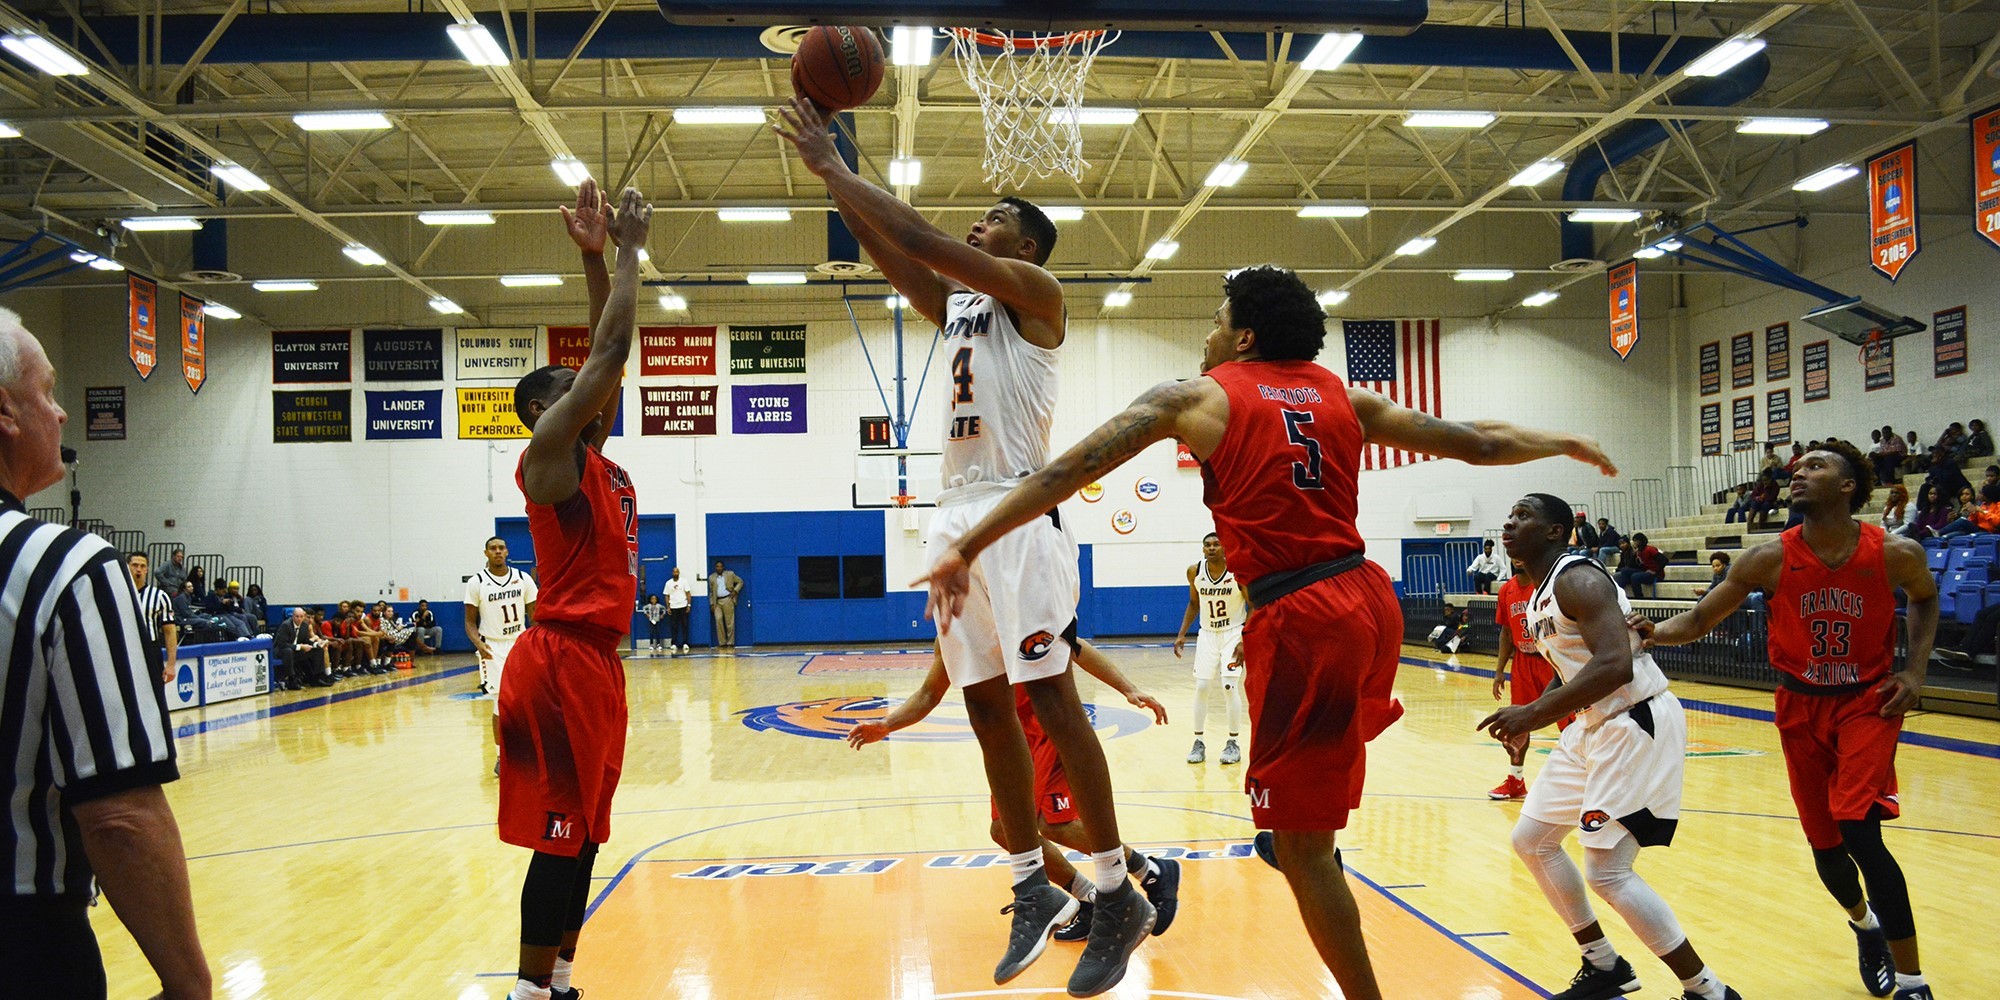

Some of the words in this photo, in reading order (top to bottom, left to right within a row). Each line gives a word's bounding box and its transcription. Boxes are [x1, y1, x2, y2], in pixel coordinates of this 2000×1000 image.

[834, 27, 863, 79] Wilso
[1878, 168, 1903, 185] SOCCER
[1986, 211, 2000, 233] 20
[1880, 241, 1908, 267] 2005
[643, 336, 676, 346] FRANCIS
[684, 336, 713, 347] MARION
[730, 330, 763, 341] GEORGIA
[771, 330, 805, 341] COLLEGE
[274, 343, 316, 352] CLAYTON
[320, 342, 349, 351] STATE
[374, 341, 433, 352] AUGUSTA
[460, 338, 501, 349] COLUMBUS
[509, 338, 533, 349] STATE
[559, 337, 590, 348] FLAG
[135, 350, 151, 367] 2011
[464, 357, 528, 368] UNIVERSITY
[560, 356, 588, 367] COLL
[647, 355, 709, 366] UNIVERSITY
[730, 358, 753, 369] STATE
[760, 357, 805, 369] UNIVERSITY
[284, 361, 339, 371] UNIVERSITY
[368, 359, 439, 371] UNIVERSITY
[951, 346, 974, 412] 4
[464, 391, 510, 401] UNIVERSITY
[647, 391, 693, 402] UNIVERSITY
[700, 390, 711, 401] OF
[1257, 384, 1322, 405] PATRIOTS
[295, 397, 328, 407] GEORGIA
[383, 400, 425, 411] LANDER
[461, 403, 488, 413] NORTH
[493, 403, 517, 413] CAROL
[749, 397, 789, 408] YOUNG
[281, 411, 342, 422] SOUTHWESTERN
[644, 406, 670, 417] SOUTH
[677, 405, 714, 416] CAROLINA
[746, 411, 792, 422] HARRIS
[373, 419, 434, 431] UNIVERSITY
[491, 415, 500, 423] AT
[276, 426, 300, 437] STATE
[304, 425, 348, 436] UNIVERSITY
[469, 425, 523, 435] PEMBROKE
[664, 420, 694, 431] AIKEN
[869, 422, 888, 441] 11
[1280, 408, 1325, 490] 5
[620, 496, 638, 544] 2
[488, 589, 522, 602] CLAYTON
[1200, 587, 1232, 595] CLAYTON
[1800, 587, 1863, 618] FRANCIS
[501, 603, 519, 624] 11
[1208, 600, 1227, 618] 12
[1510, 600, 1530, 618] FRAN
[1210, 618, 1230, 628] STATE
[502, 624, 521, 635] STATE
[1810, 619, 1851, 658] 33
[208, 656, 231, 667] Official
[231, 655, 247, 663] Home
[211, 668, 219, 679] of
[218, 668, 227, 676] the
[228, 665, 247, 675] CCSU
[1802, 658, 1859, 685] MARION
[178, 682, 195, 693] NCAA
[206, 680, 224, 690] Laker
[225, 677, 238, 687] Golf
[239, 677, 253, 685] Team
[924, 842, 1256, 869] Peah
